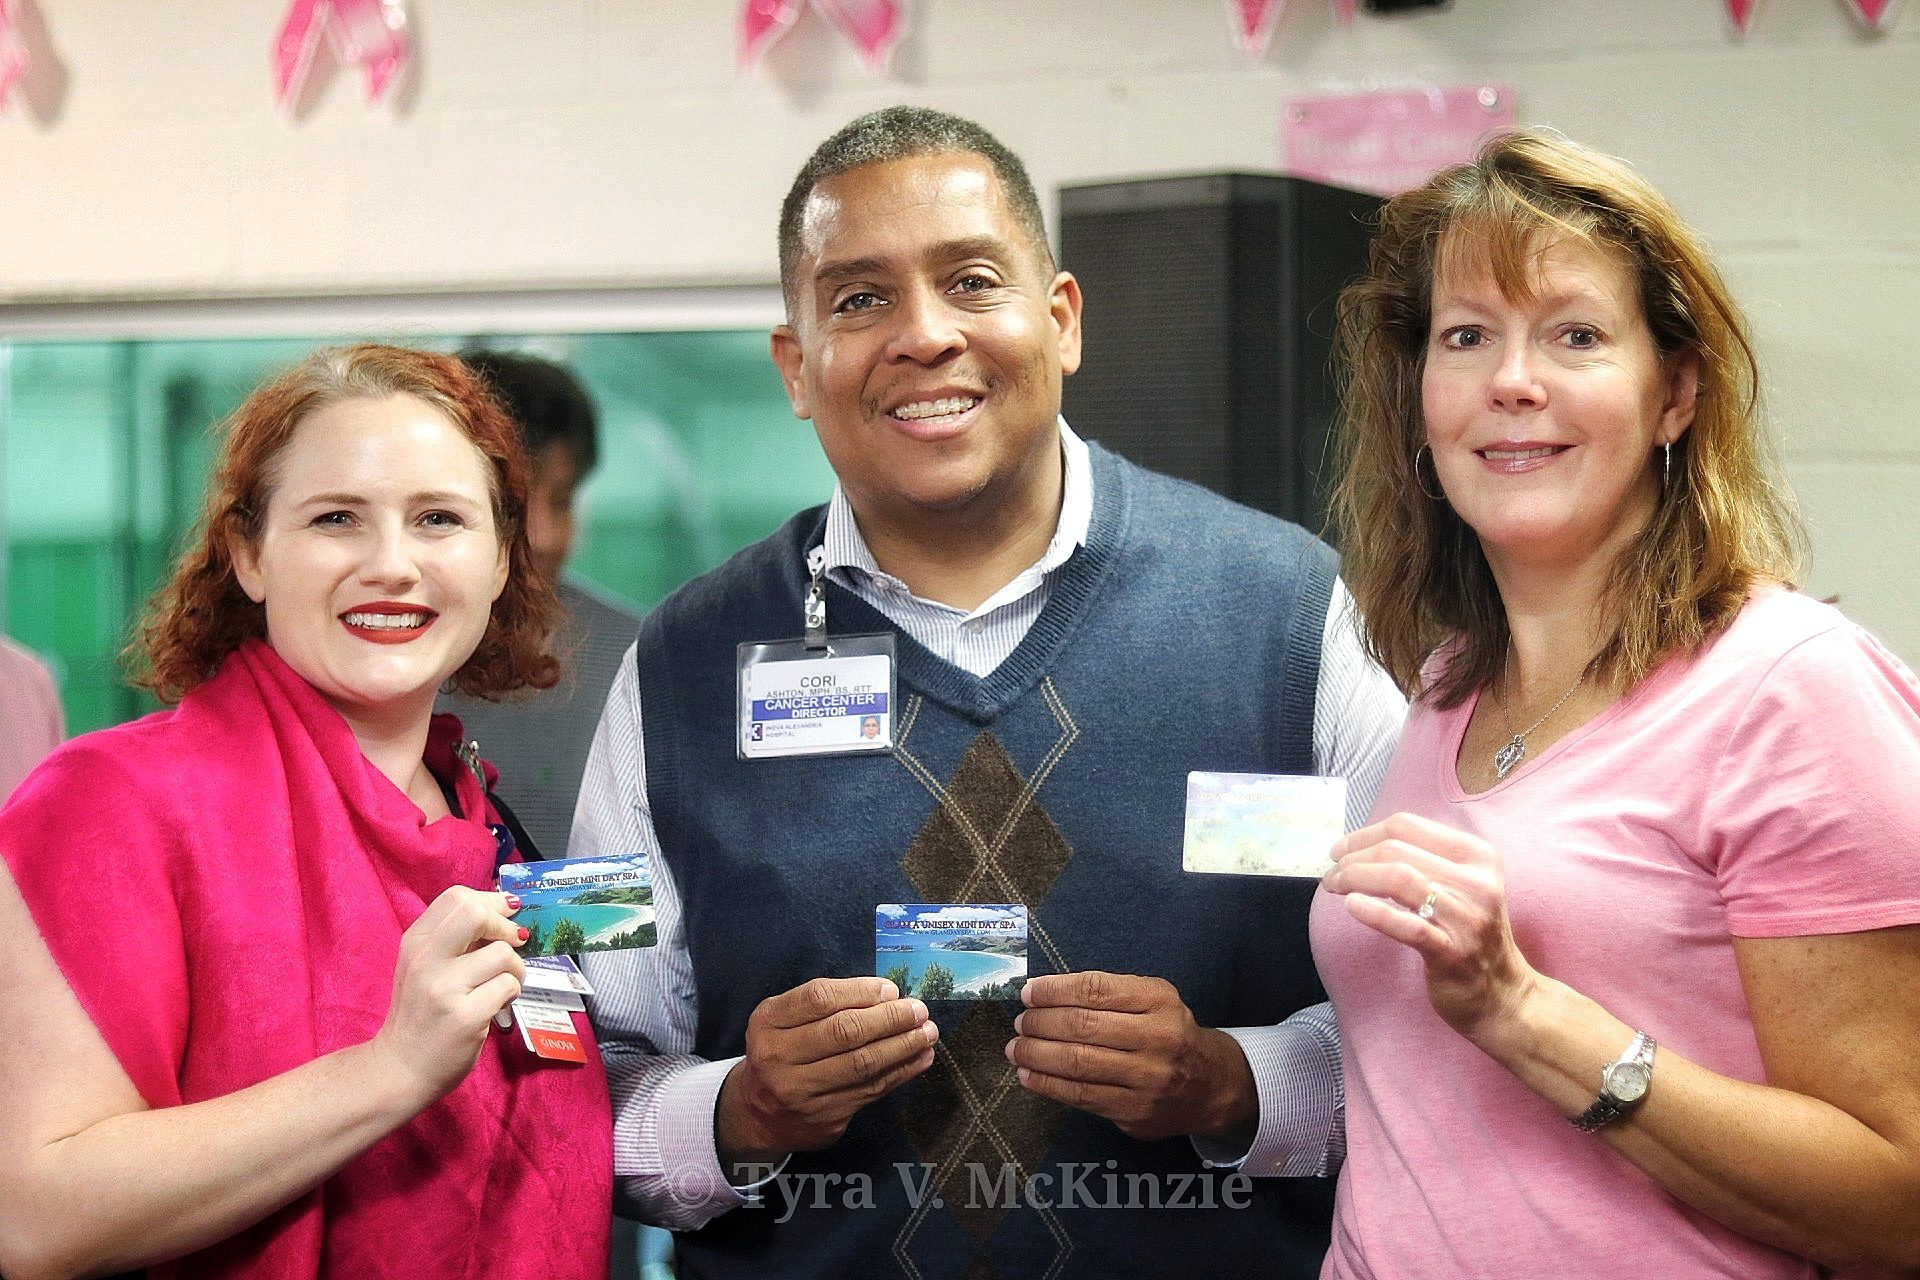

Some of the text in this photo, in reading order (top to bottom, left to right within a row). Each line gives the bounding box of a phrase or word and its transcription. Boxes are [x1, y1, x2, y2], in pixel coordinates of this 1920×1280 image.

[800, 675, 837, 688] CORI
[854, 685, 872, 693] RTT
[765, 694, 875, 711] CANCER CENTER
[792, 707, 847, 718] DIRECTOR
[548, 877, 580, 887] UNISEX
[580, 874, 600, 884] MINI
[602, 873, 621, 882] DAY
[623, 872, 639, 880] SPA
[921, 920, 955, 929] UNISEX
[956, 920, 977, 929] MINI
[978, 920, 999, 929] DAY
[999, 920, 1017, 929] SPA
[547, 1038, 576, 1052] INOVA
